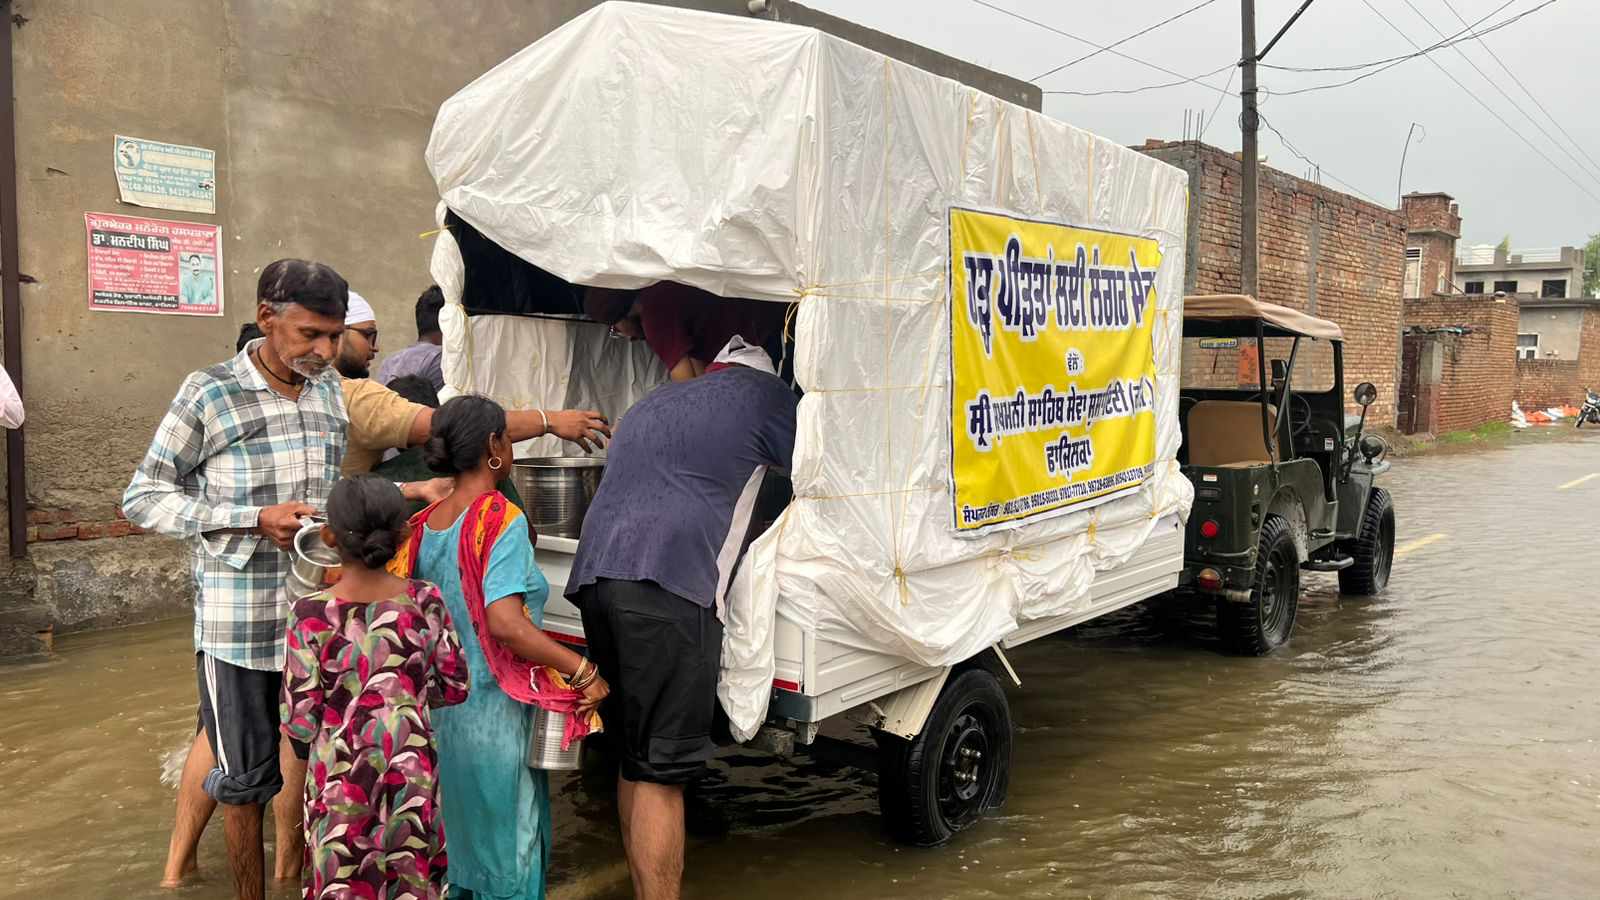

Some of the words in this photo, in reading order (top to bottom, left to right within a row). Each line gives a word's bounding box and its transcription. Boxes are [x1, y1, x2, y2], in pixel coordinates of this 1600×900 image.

[1056, 246, 1086, 327] ਲਈ
[1089, 248, 1129, 327] ਲੰਗਰ
[970, 393, 992, 446] ਸ੍ਰੀ
[1028, 388, 1064, 425] ਸਾਹਿਬ
[1067, 386, 1086, 422] ਸੇਵਾ
